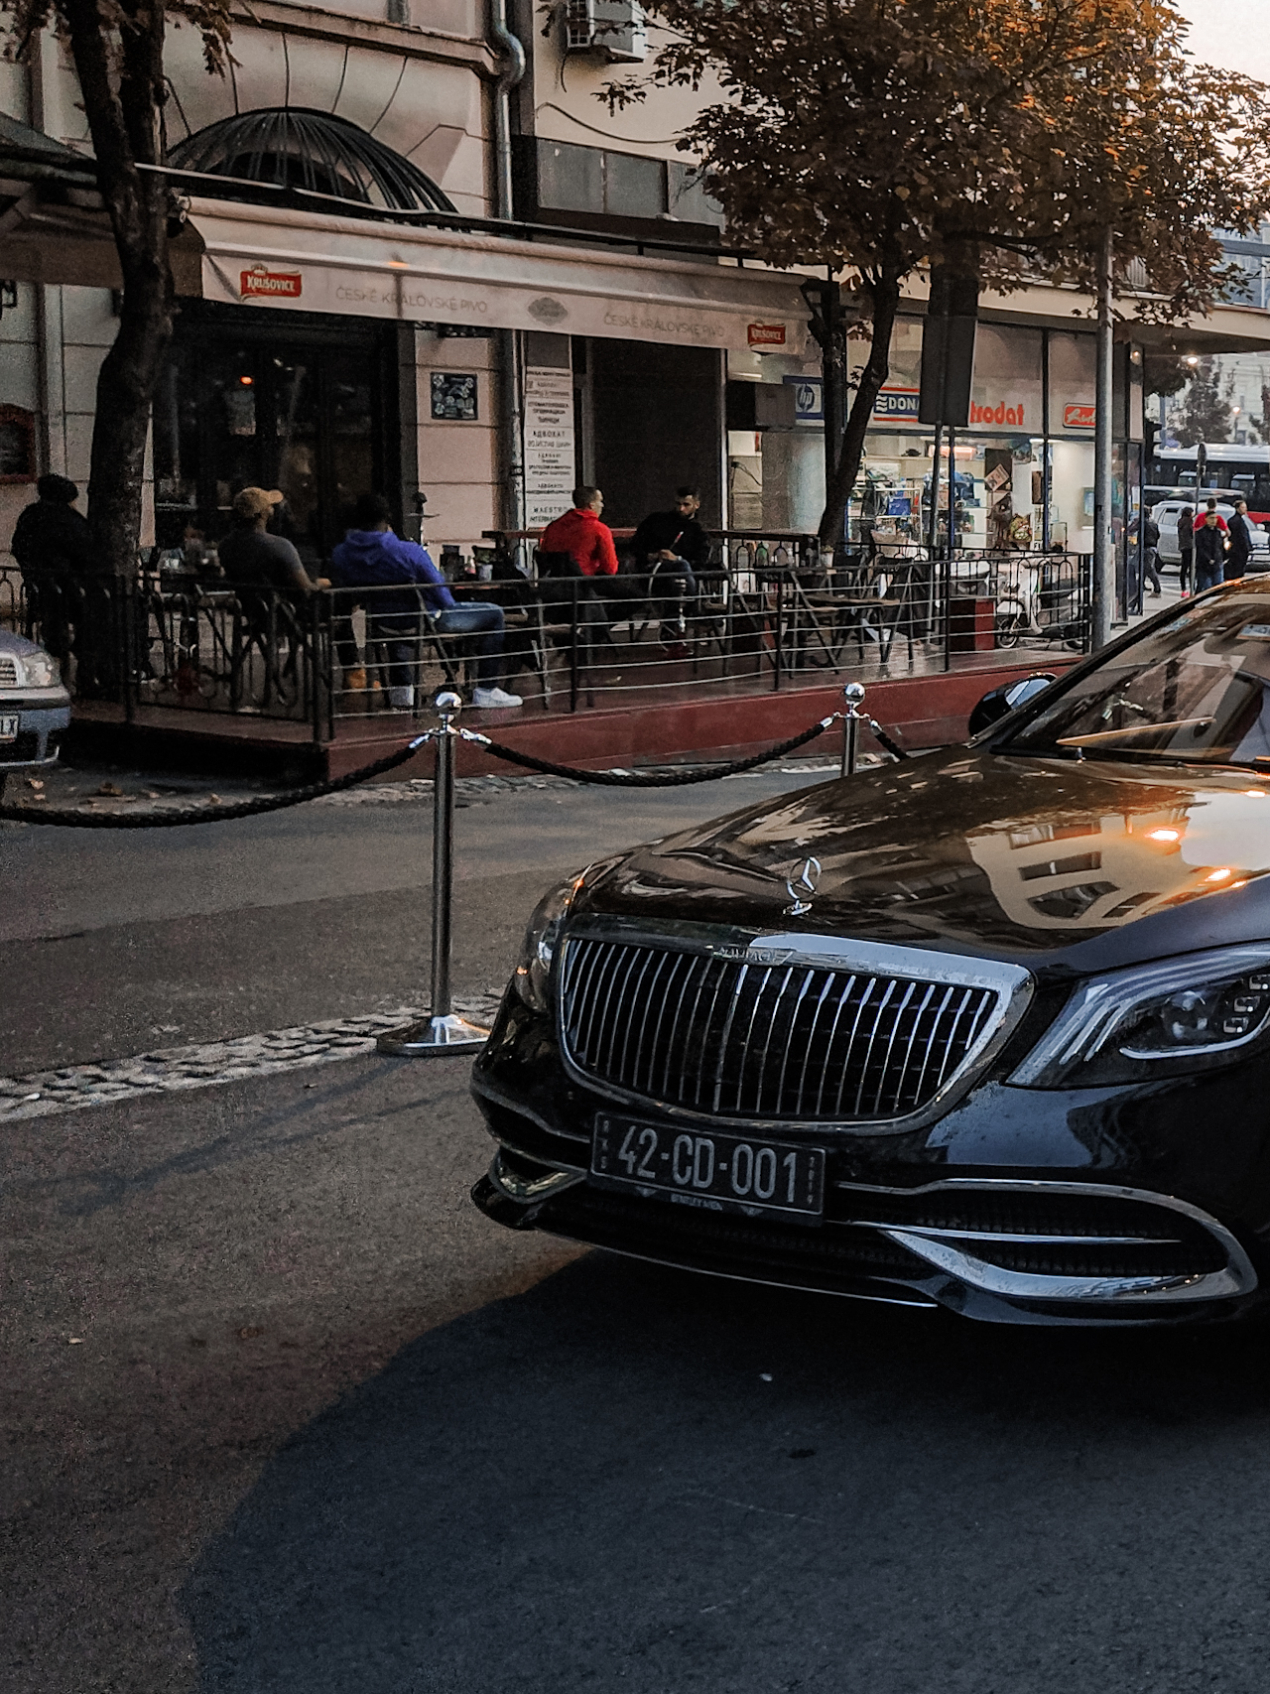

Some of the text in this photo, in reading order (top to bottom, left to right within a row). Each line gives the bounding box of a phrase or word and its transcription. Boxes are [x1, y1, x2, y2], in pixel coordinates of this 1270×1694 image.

[247, 275, 296, 292] KRUŠOVICE
[460, 299, 488, 314] PIVO
[888, 397, 920, 411] DON
[617, 1125, 798, 1203] 42-CD-001
